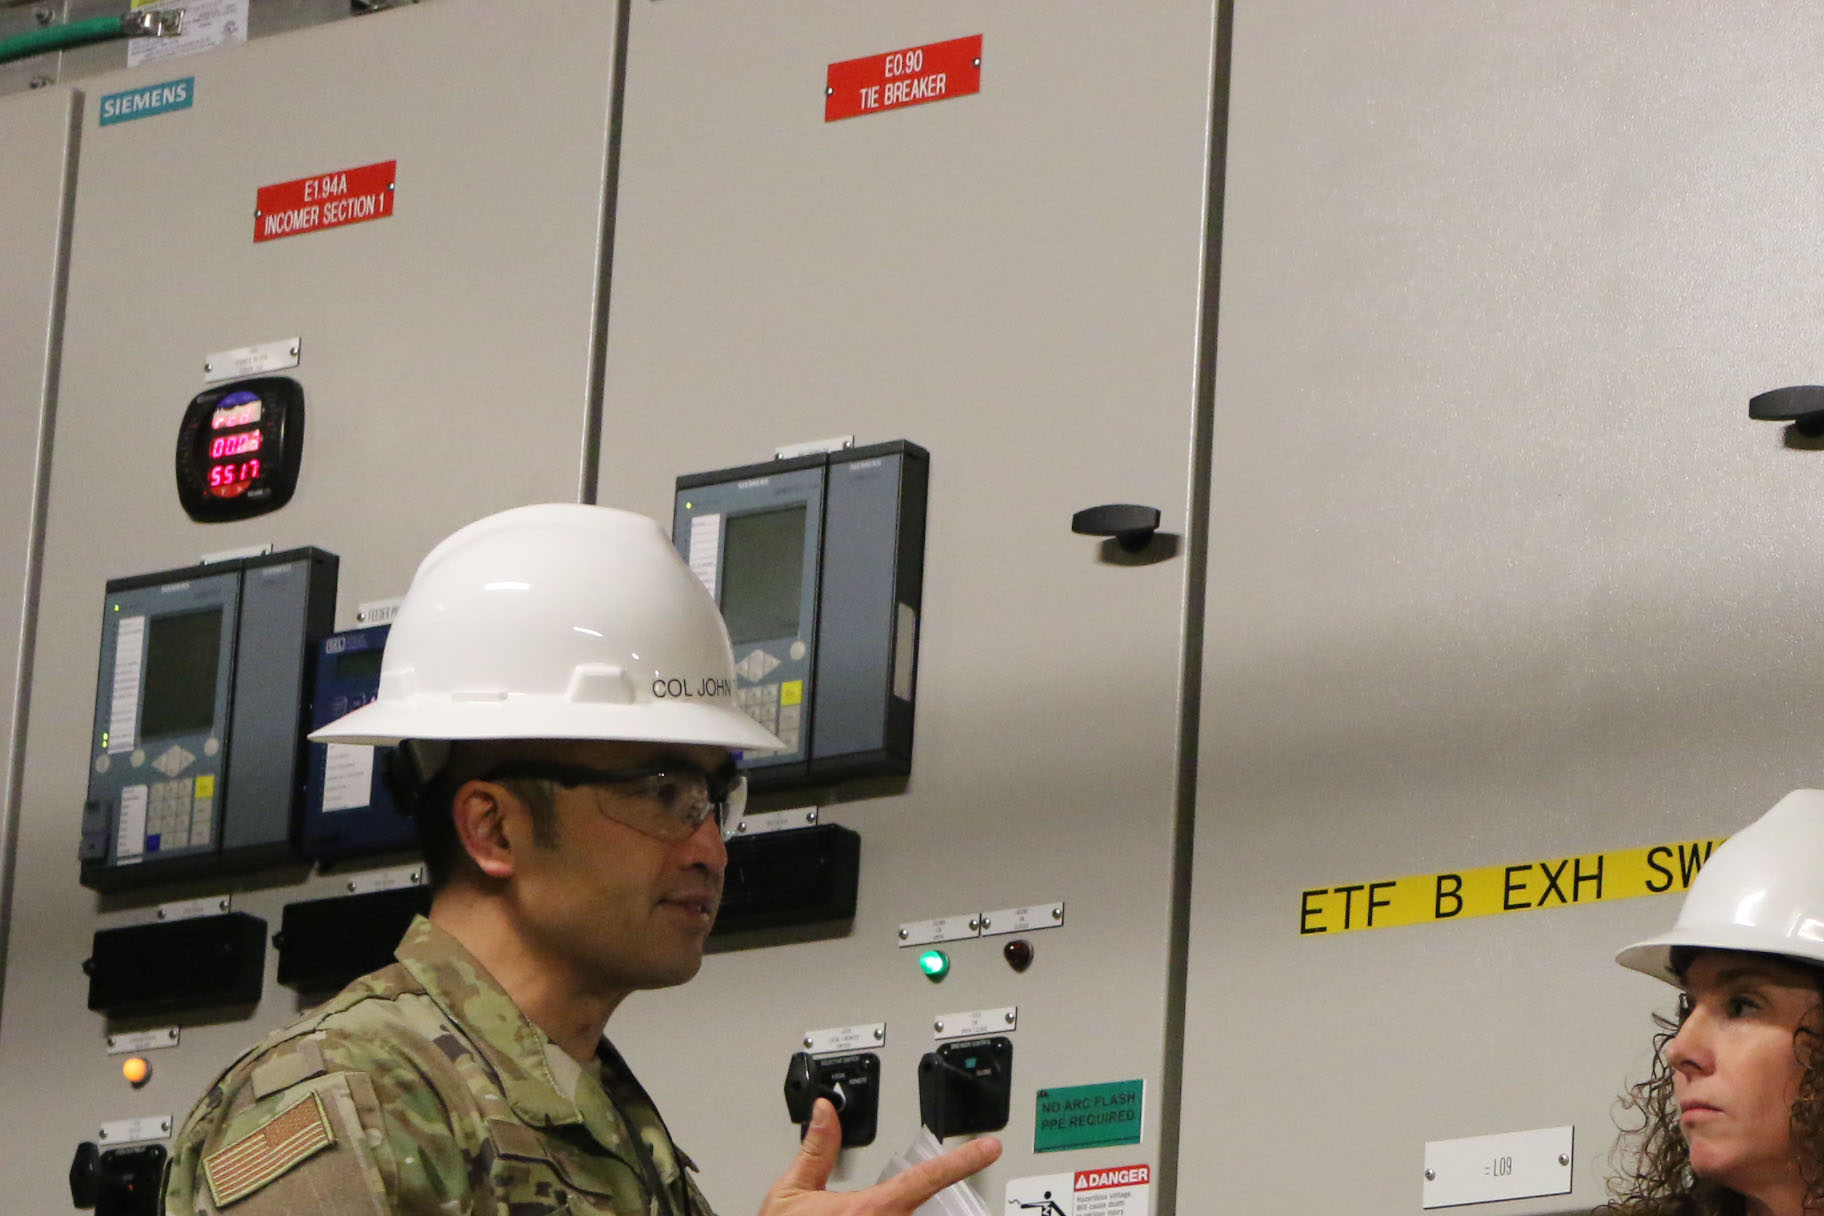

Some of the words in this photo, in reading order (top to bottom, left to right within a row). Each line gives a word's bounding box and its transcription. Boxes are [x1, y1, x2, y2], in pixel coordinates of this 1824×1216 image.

[885, 49, 923, 78] E0.90
[103, 82, 187, 118] SIEMENS
[860, 85, 880, 110] TIE
[884, 73, 947, 106] BREAKER
[304, 173, 348, 202] E1.94A
[264, 205, 319, 236] INCOMER
[323, 194, 375, 225] SECTION
[379, 192, 385, 213] 1
[652, 678, 693, 698] COL
[697, 677, 731, 697] JOHN
[1300, 881, 1396, 935] ETF
[1434, 873, 1463, 920] B
[1503, 855, 1604, 911] EXH
[1645, 838, 1727, 893] SW
[1042, 1101, 1061, 1113] NO
[1064, 1098, 1090, 1110] ARC
[1094, 1092, 1136, 1107] FLASH
[1042, 1118, 1066, 1130] PPE
[1069, 1110, 1136, 1128] REQUIRED
[1089, 1167, 1149, 1187] DANGER
